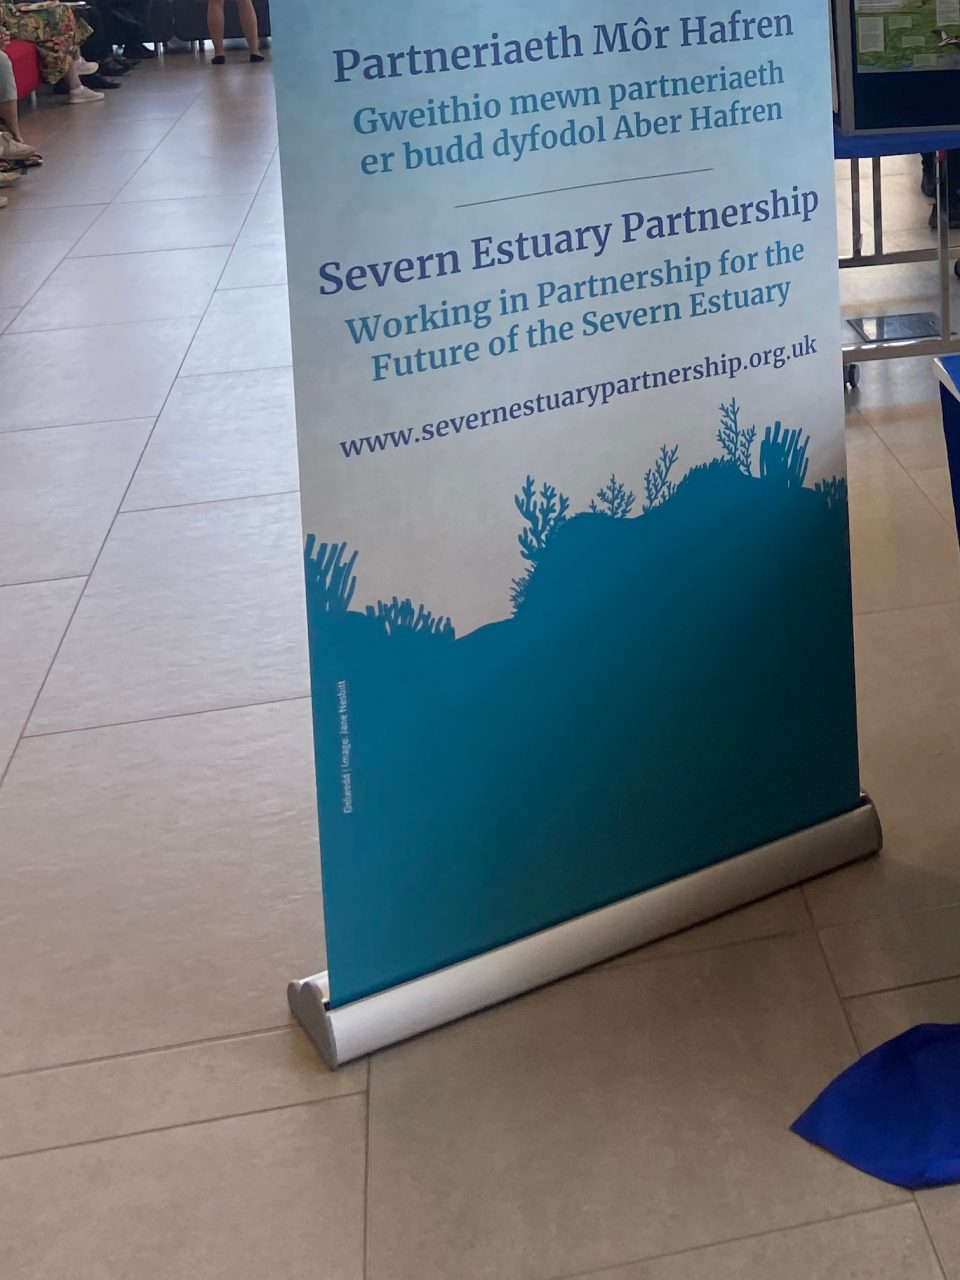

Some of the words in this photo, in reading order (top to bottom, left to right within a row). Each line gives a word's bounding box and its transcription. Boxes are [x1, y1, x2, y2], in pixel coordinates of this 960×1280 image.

[332, 24, 585, 84] Partneriaeth
[592, 16, 670, 56] Môr
[679, 9, 794, 49] Hafren
[353, 93, 502, 136] Gweithio
[509, 86, 601, 117] mewn
[608, 60, 785, 106] partneriaeth
[360, 150, 395, 176] er
[403, 130, 485, 170] budd
[492, 115, 606, 161] dyfodol
[612, 111, 683, 140] Aber
[689, 99, 784, 131] Hafren
[317, 248, 462, 297] Severn
[470, 221, 613, 271] Estuary
[620, 185, 820, 244] Partnership
[344, 297, 492, 347] Working
[499, 288, 530, 316] in
[536, 258, 713, 310] Partnership
[717, 247, 759, 277] for
[764, 239, 805, 268] the
[369, 337, 480, 382] Future
[488, 320, 519, 357] of
[526, 317, 574, 349] the
[581, 297, 682, 336] Severn
[687, 277, 792, 319] Estuary
[338, 334, 819, 458] www.severnestuarypartnership.org.uk
